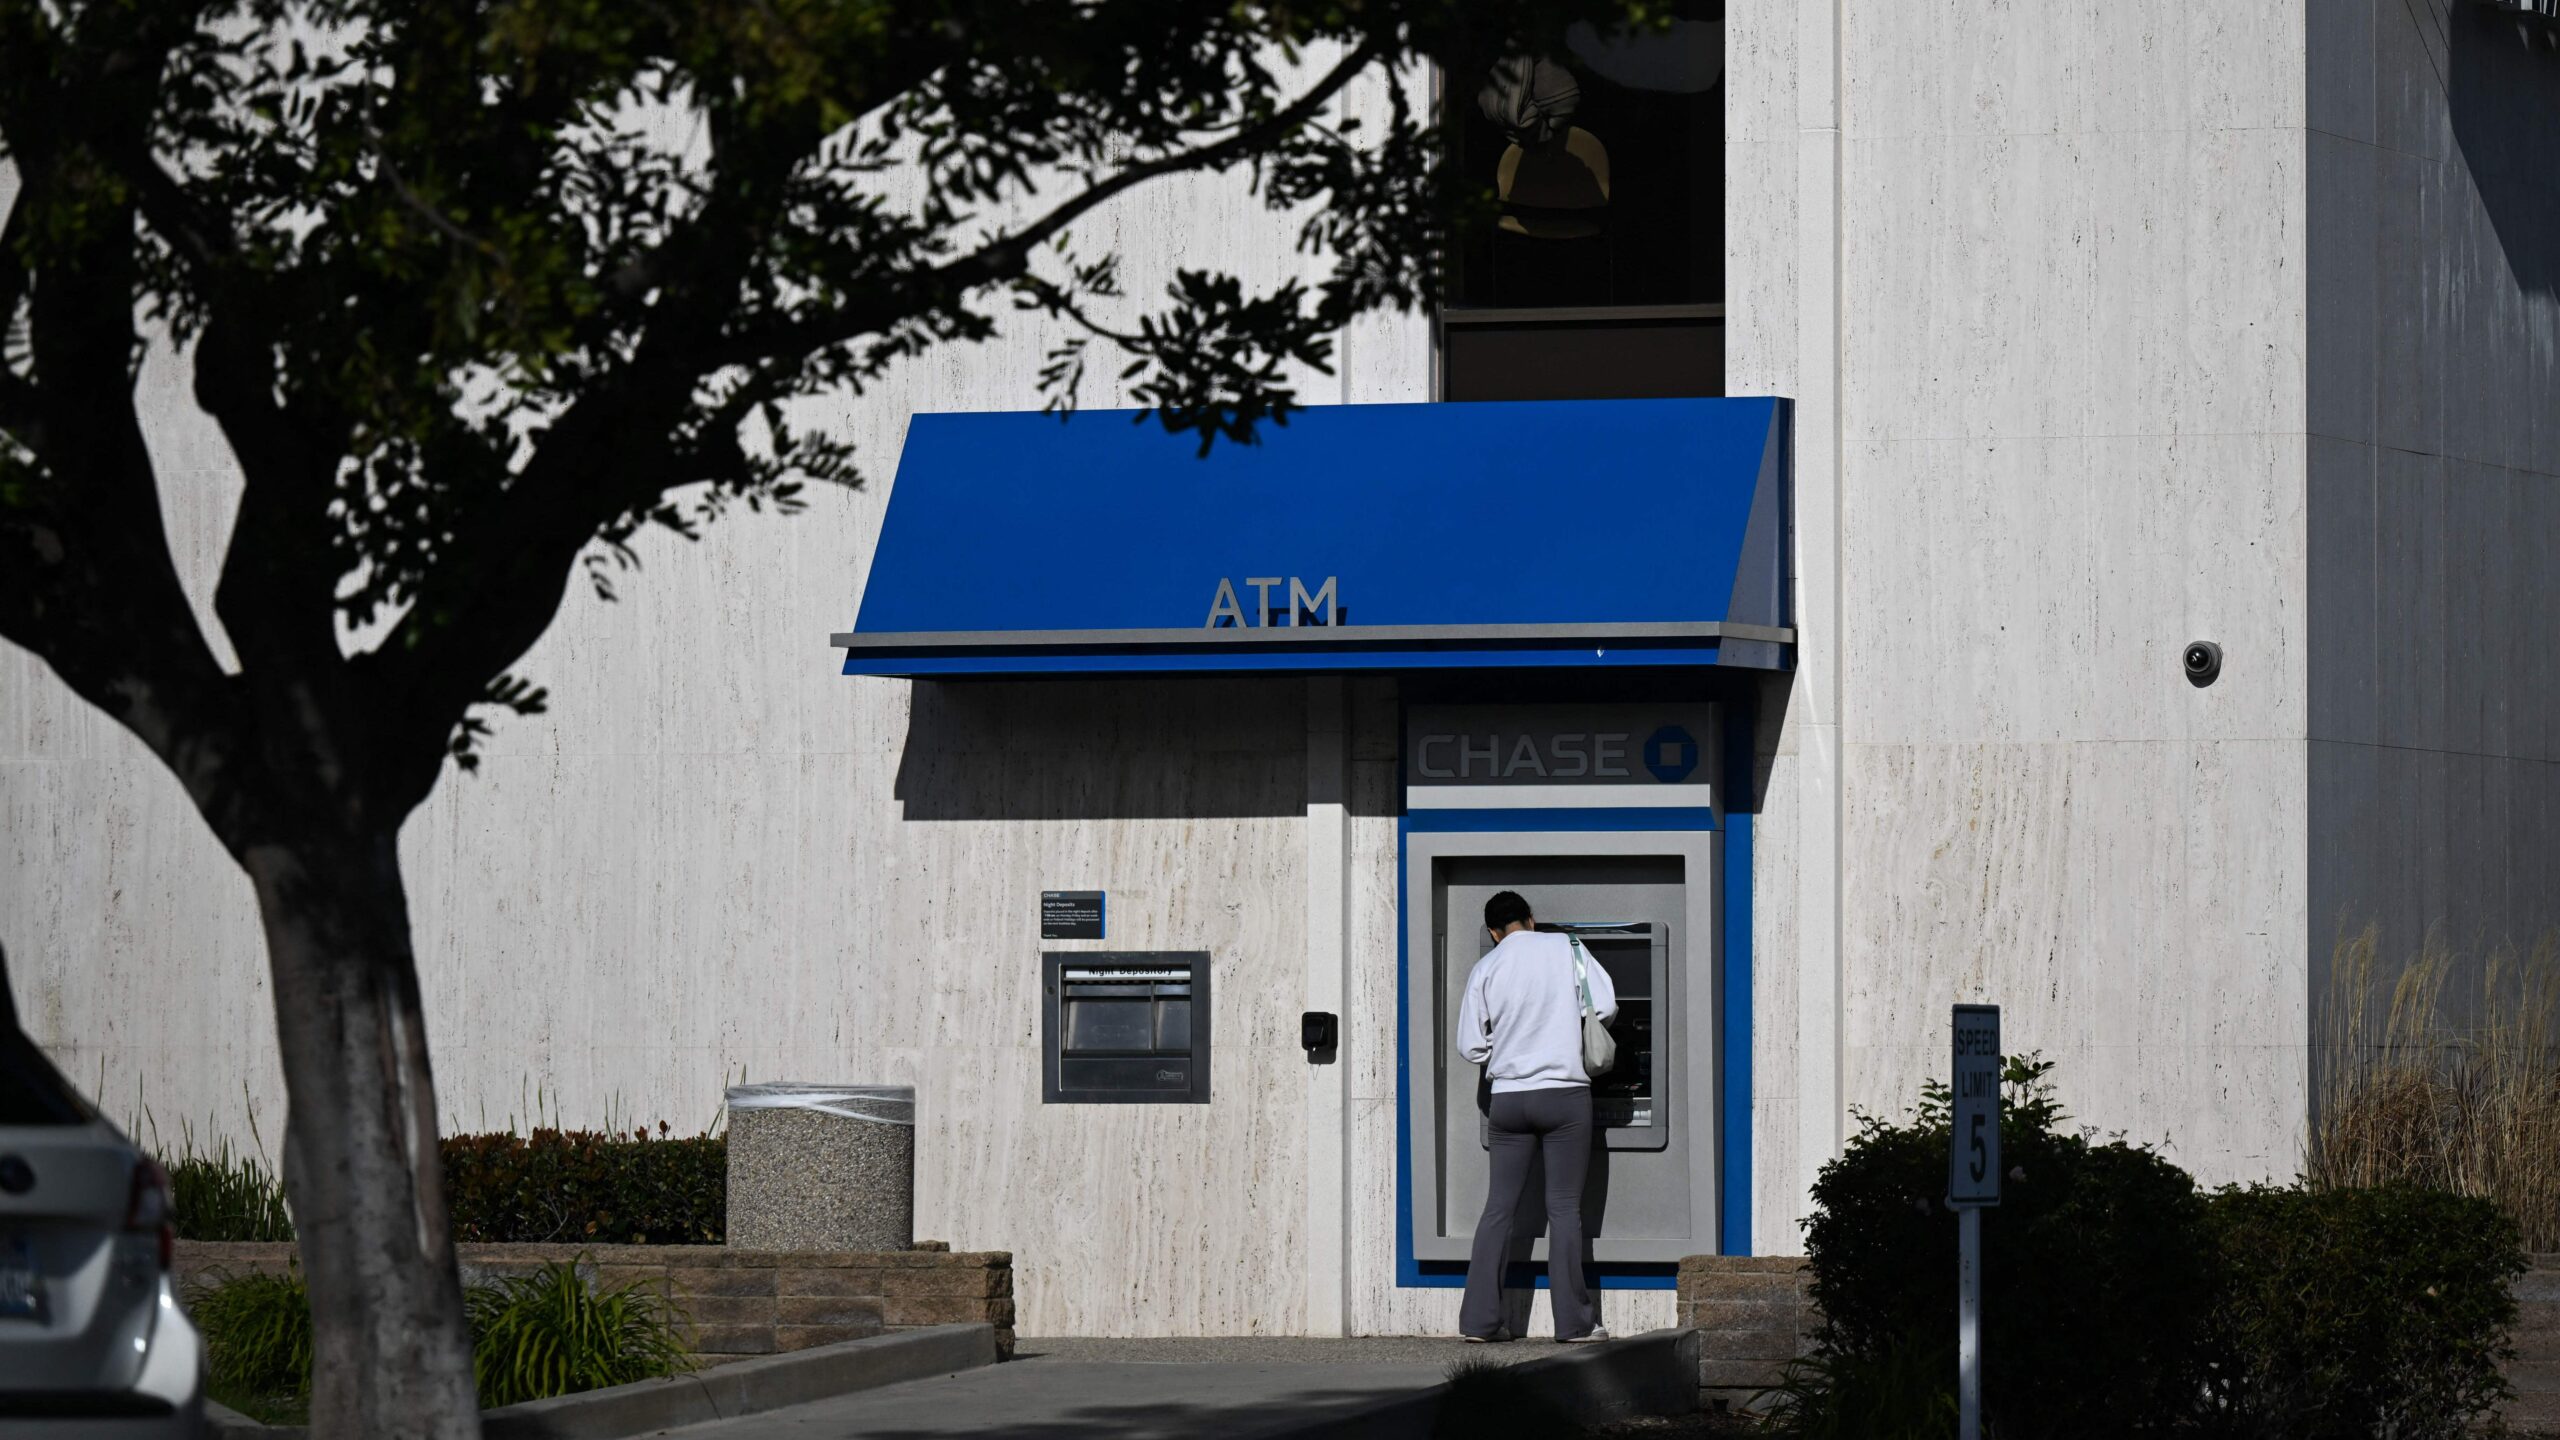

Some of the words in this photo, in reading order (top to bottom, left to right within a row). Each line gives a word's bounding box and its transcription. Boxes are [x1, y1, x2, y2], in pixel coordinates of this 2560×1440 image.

[1204, 576, 1337, 629] ATM
[1418, 733, 1631, 778] CHASE
[1957, 1028, 1998, 1056] SPEED
[1962, 1071, 1993, 1098] LIMIT
[1969, 1114, 1987, 1184] 5
